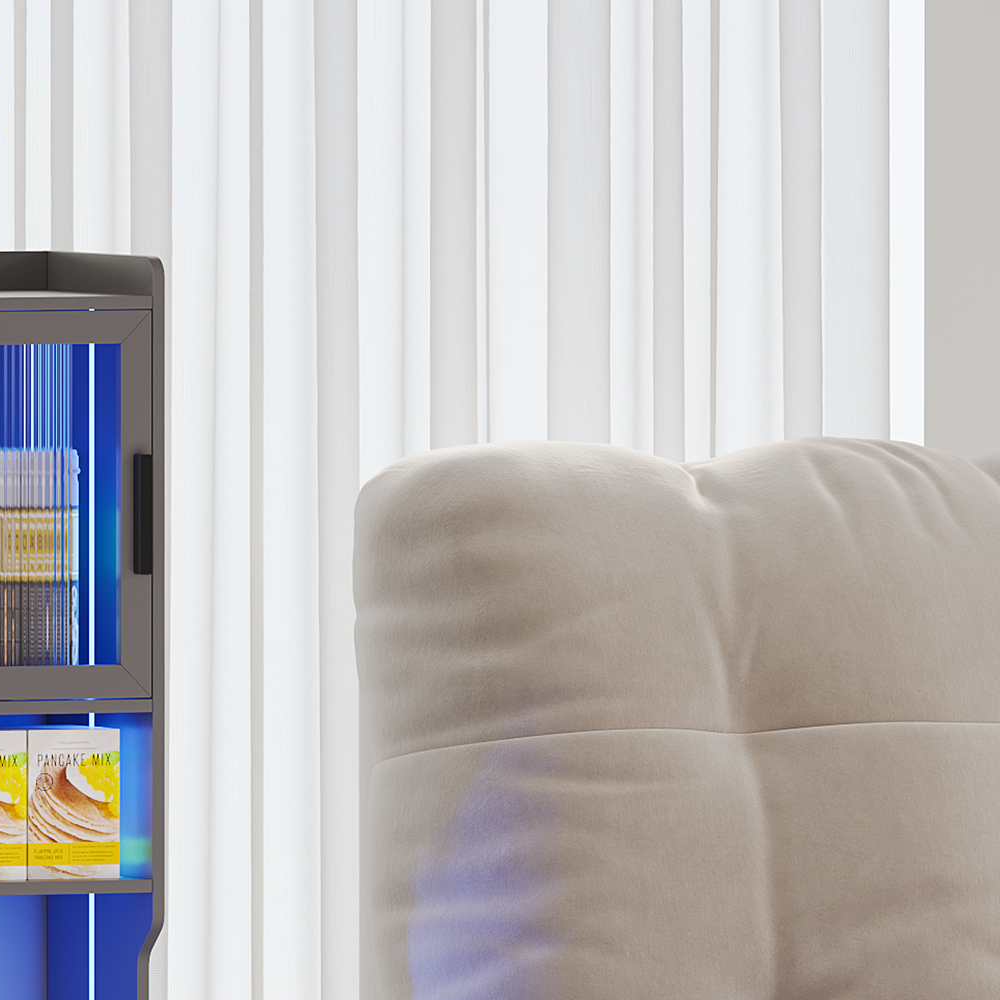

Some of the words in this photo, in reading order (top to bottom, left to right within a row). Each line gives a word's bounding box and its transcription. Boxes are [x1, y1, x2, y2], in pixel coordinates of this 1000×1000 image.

[0, 755, 18, 768] MIX
[38, 753, 86, 766] PANCAKE
[92, 753, 110, 766] MIX
